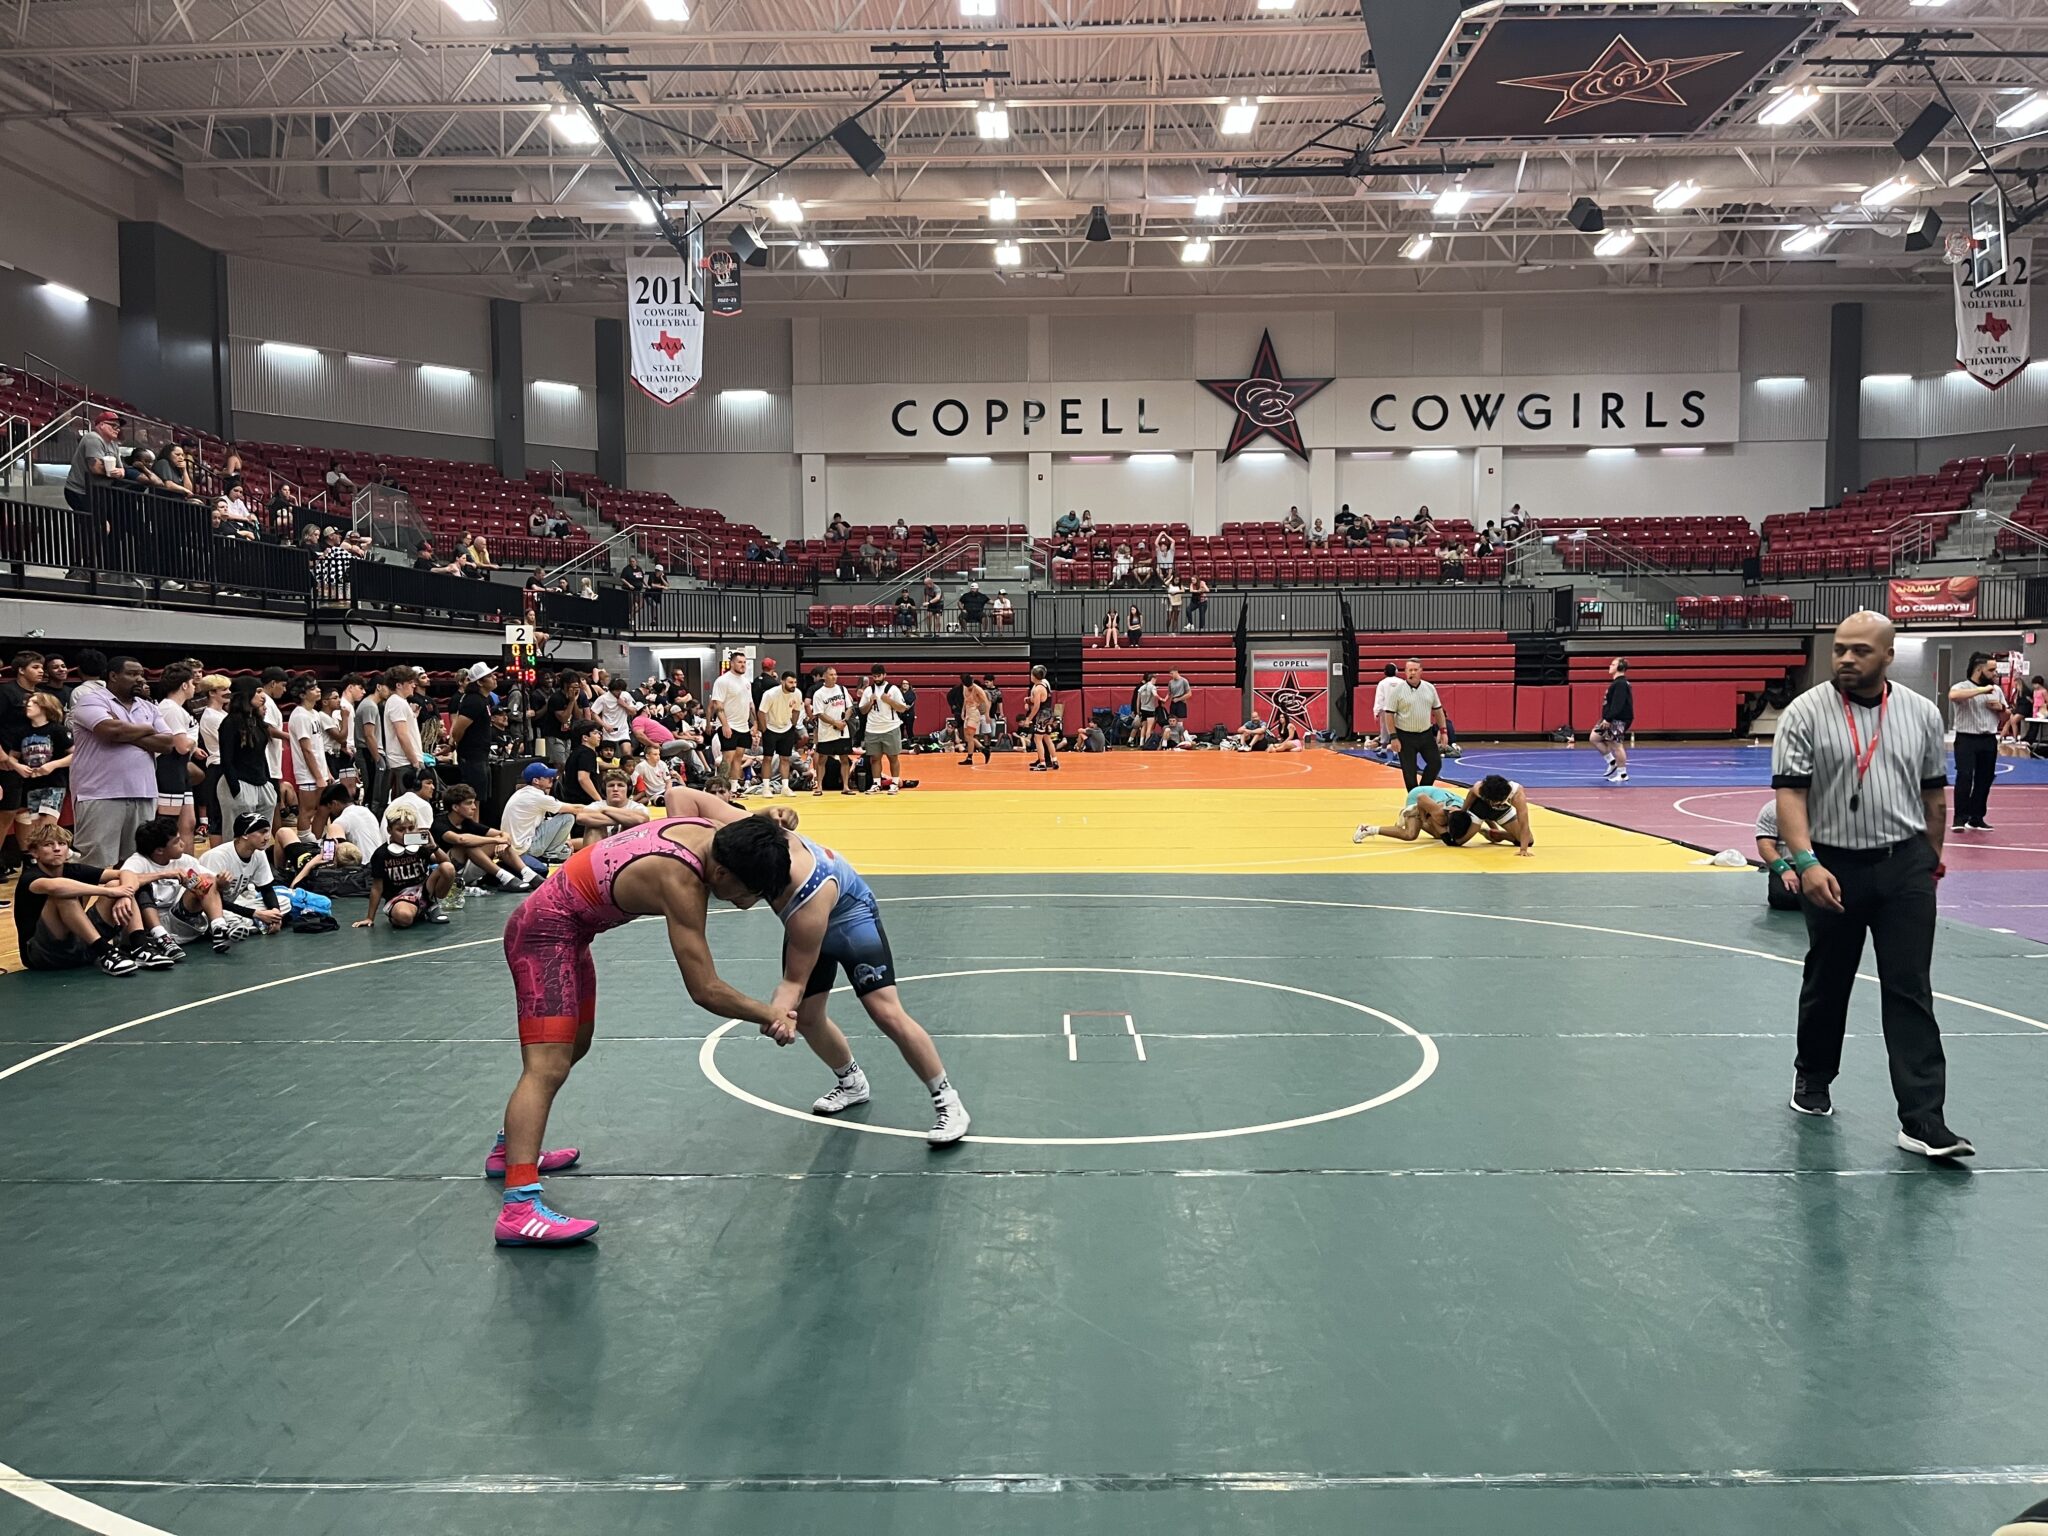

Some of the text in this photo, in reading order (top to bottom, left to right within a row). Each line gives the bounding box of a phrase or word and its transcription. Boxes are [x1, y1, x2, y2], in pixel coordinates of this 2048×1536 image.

[1969, 289, 2016, 299] COWGIRL
[1962, 299, 2026, 310] VOLLEYBALL
[643, 308, 690, 317] COWGIRL
[636, 319, 698, 327] VOLLEYBALL
[1977, 346, 2009, 355] STATE
[1964, 356, 2022, 367] CHAMPIONS
[652, 364, 682, 373] STATE
[639, 374, 697, 383] CHAMPIONS
[1370, 390, 1706, 432] COWGIRLS
[891, 398, 1160, 437] COPPELL
[1895, 603, 1970, 613] GO COWBOYS!
[516, 628, 525, 641] 2
[512, 644, 534, 656] 0 0
